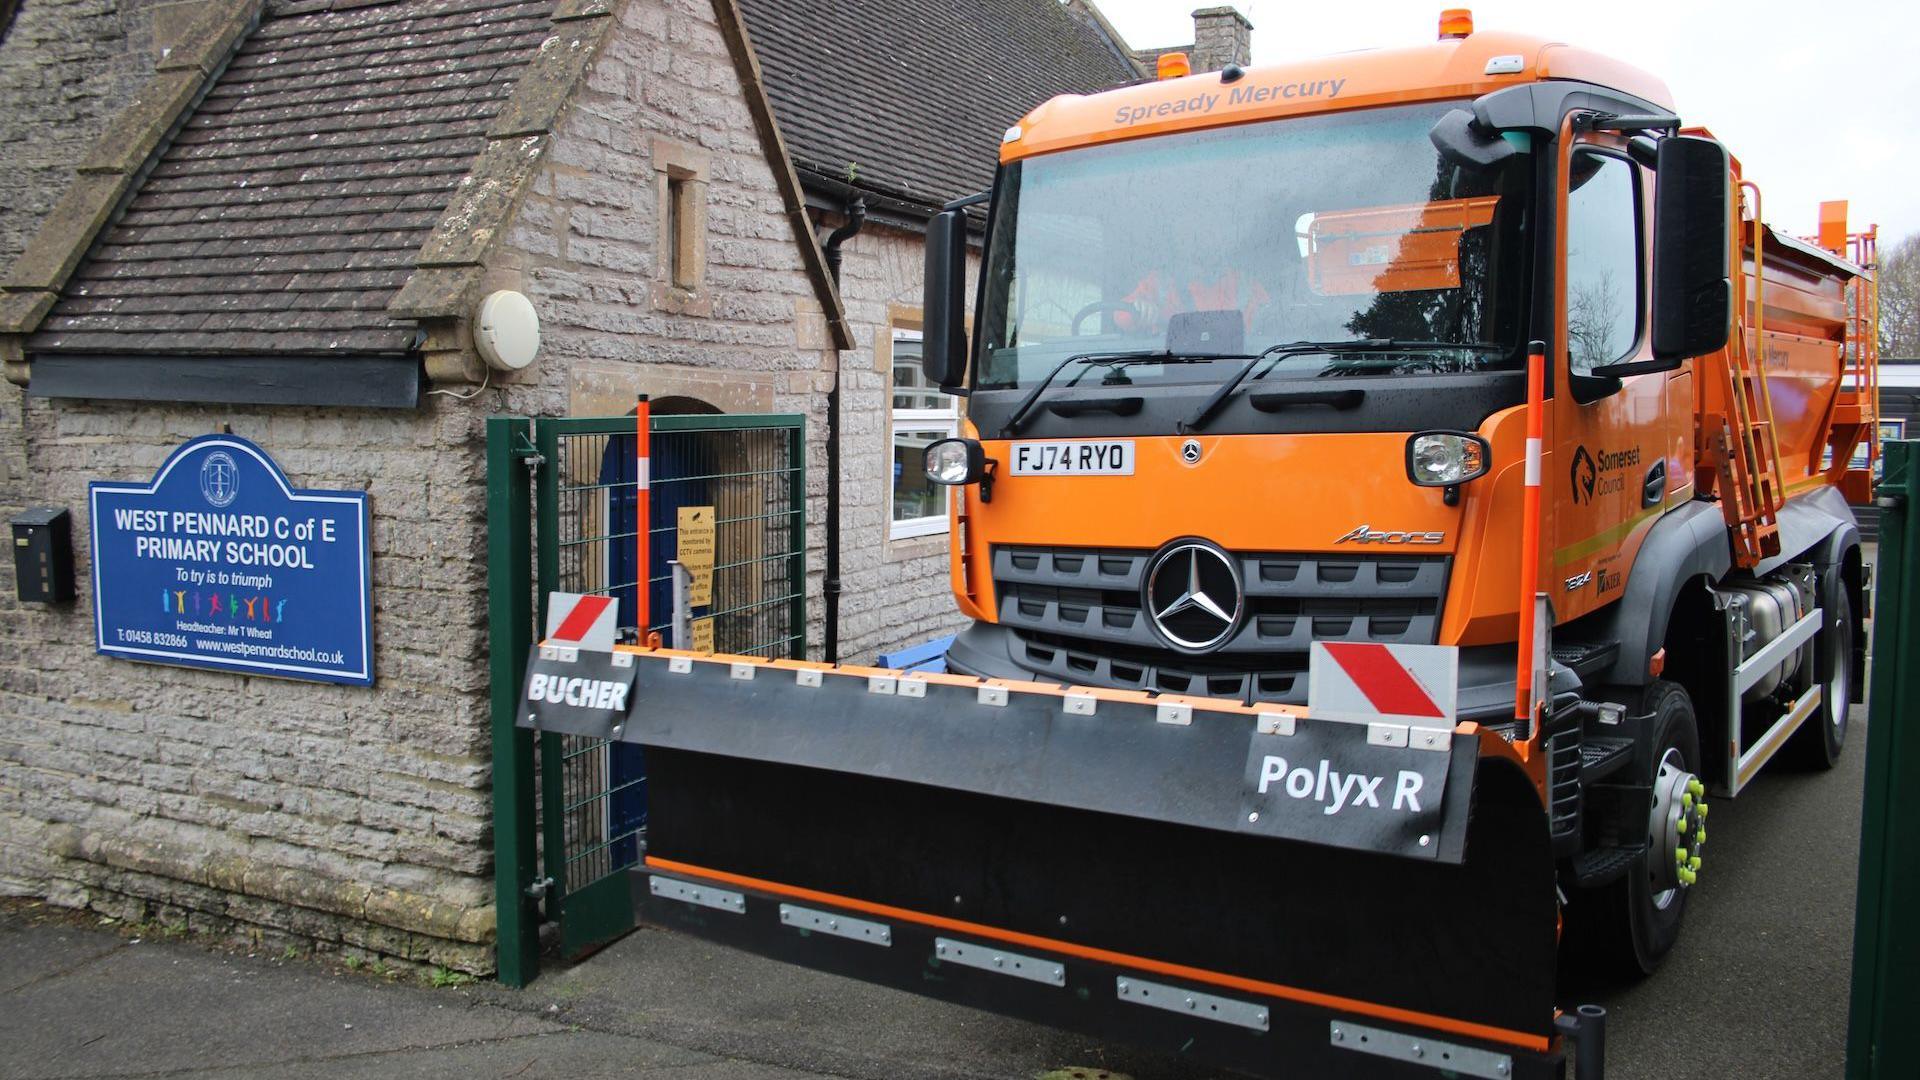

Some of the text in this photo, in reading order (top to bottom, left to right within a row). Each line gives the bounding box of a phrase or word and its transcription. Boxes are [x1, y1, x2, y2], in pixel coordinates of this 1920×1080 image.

[1114, 78, 1346, 125] Spready Mercury
[1018, 444, 1123, 471] FJ74 RYO
[1597, 445, 1640, 473] Somerset
[1597, 472, 1625, 496] Council
[114, 508, 336, 542] WEST PENNARD C of E
[136, 536, 314, 569] PRIMARY SCHOOL
[679, 547, 692, 556] CCTV
[176, 567, 272, 590] To try is to triumph
[176, 620, 272, 639] Headteacher: Mr T Wheat
[125, 629, 152, 644] 01458
[153, 632, 188, 648] 832866
[196, 639, 345, 665] www.westpennardschool.co.uk
[528, 673, 629, 711] BUCHER
[1258, 755, 1421, 815] Polyx R
